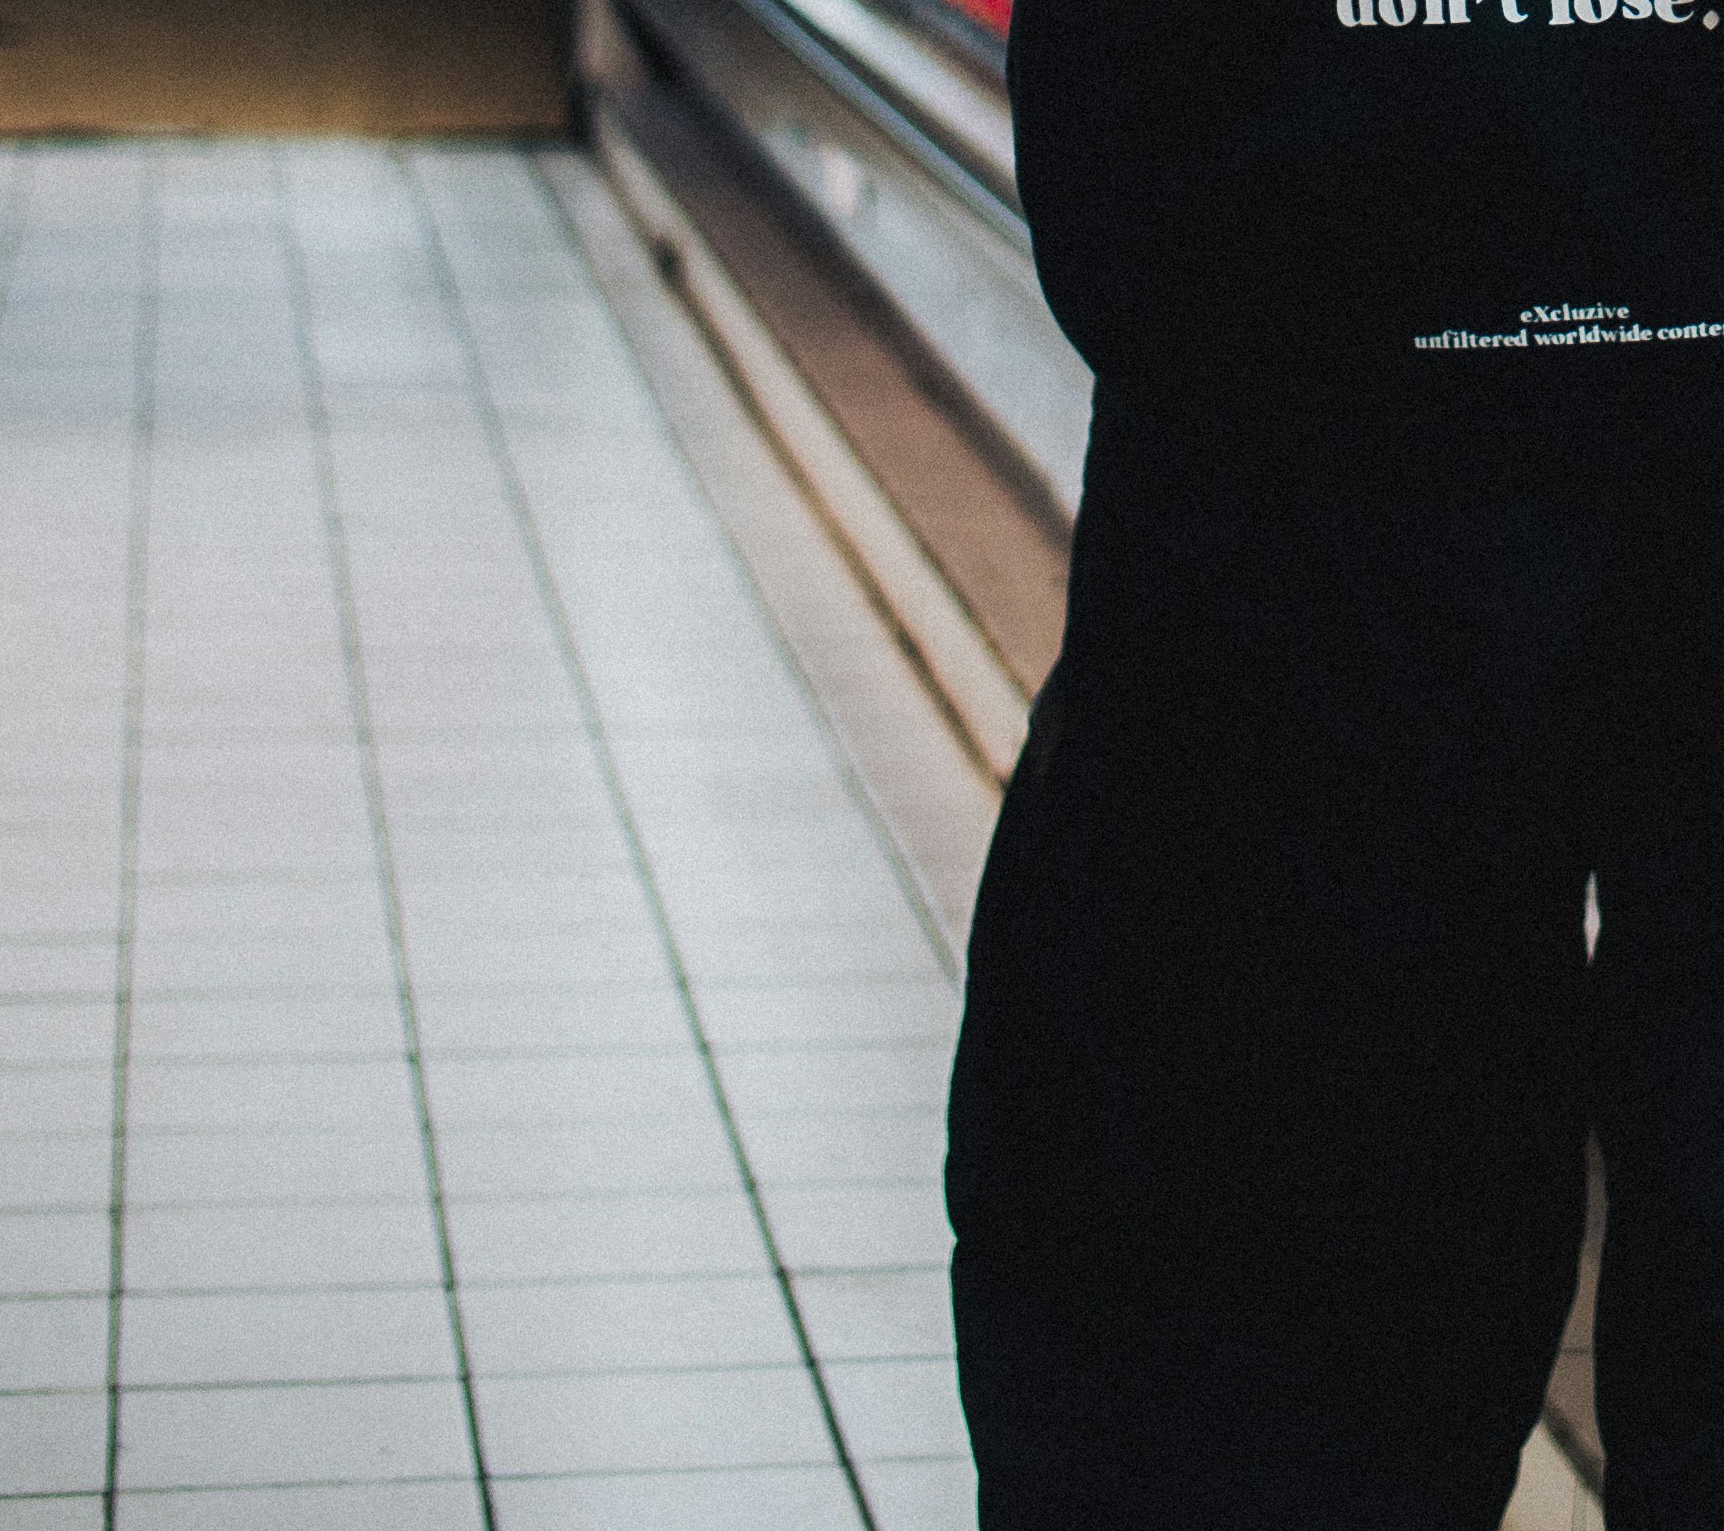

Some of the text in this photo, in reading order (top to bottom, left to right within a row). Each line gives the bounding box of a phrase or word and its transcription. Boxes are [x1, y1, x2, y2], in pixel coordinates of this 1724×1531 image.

[1519, 302, 1630, 323] eXcluzive
[1414, 329, 1528, 349] unfiltered
[1534, 324, 1653, 346] worldwide
